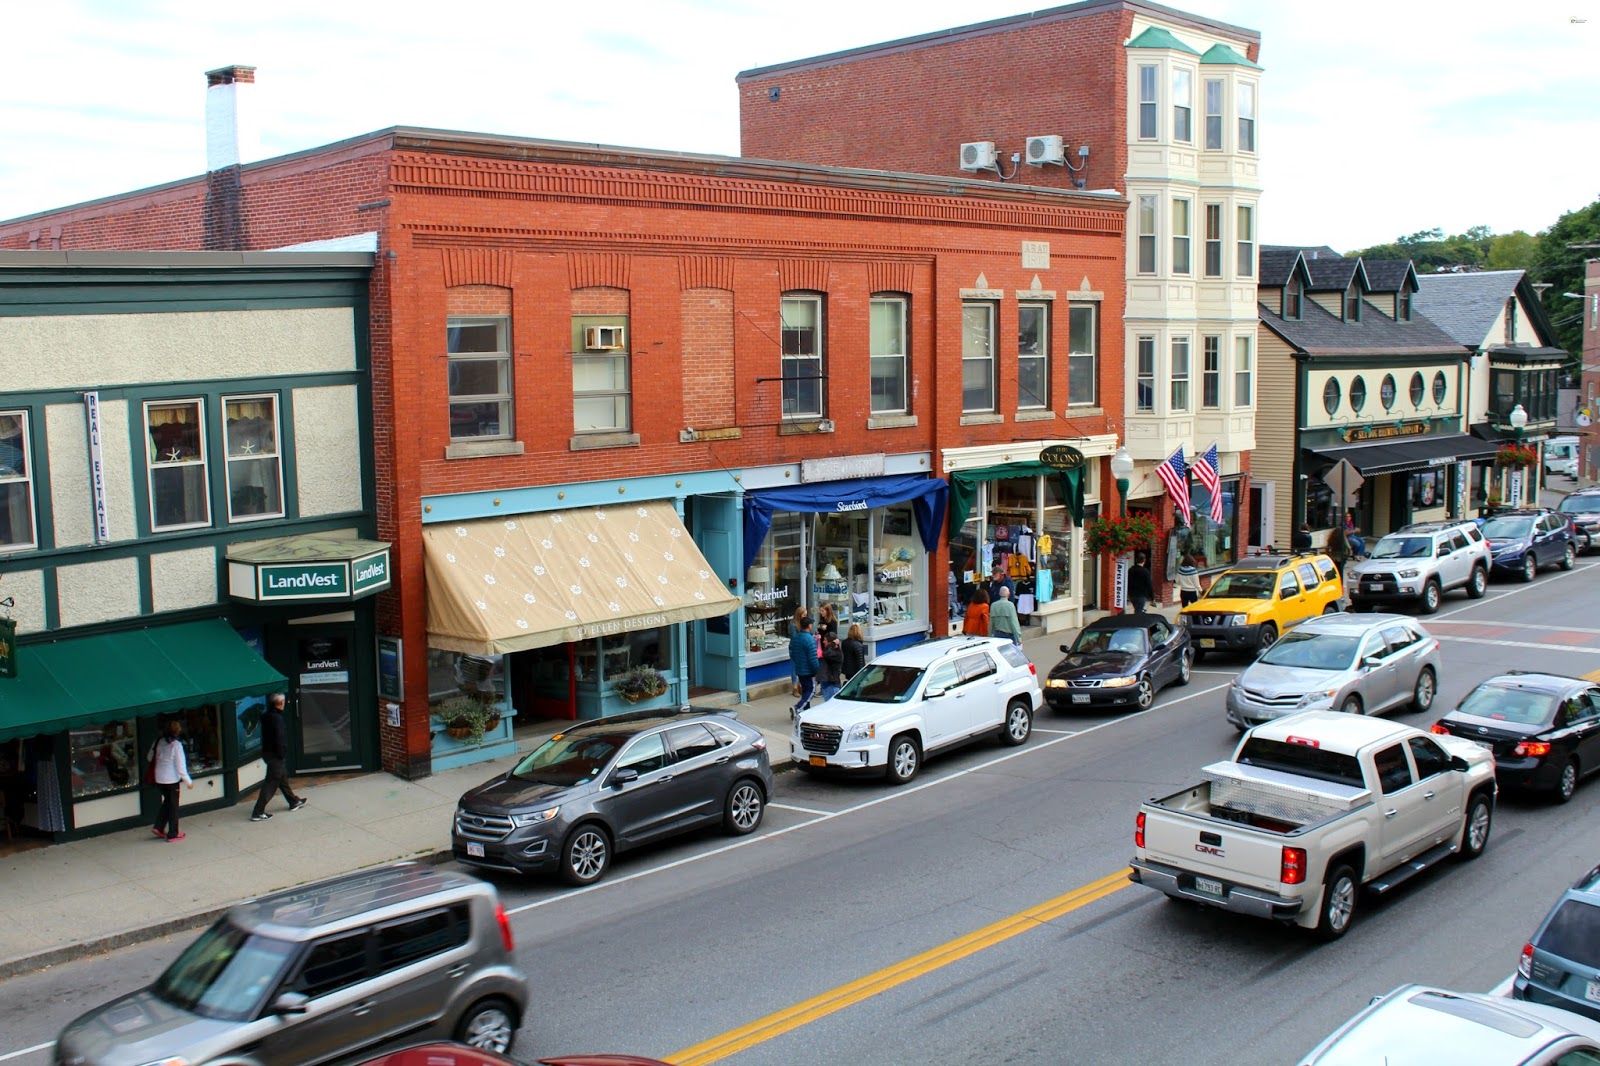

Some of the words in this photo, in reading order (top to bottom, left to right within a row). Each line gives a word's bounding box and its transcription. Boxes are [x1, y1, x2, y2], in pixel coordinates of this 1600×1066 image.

[1041, 453, 1081, 463] COLONY
[89, 395, 98, 446] REAL
[94, 461, 106, 537] ESTATE
[836, 500, 868, 512] Starbird
[356, 562, 384, 582] LandVest
[882, 564, 912, 579] Starbird
[269, 573, 338, 588] LandVest
[754, 585, 788, 602] Starbird
[591, 621, 620, 635] ELLEN
[624, 614, 667, 629] DESIGNS
[307, 661, 339, 669] LandVest
[1195, 844, 1225, 858] GMC
